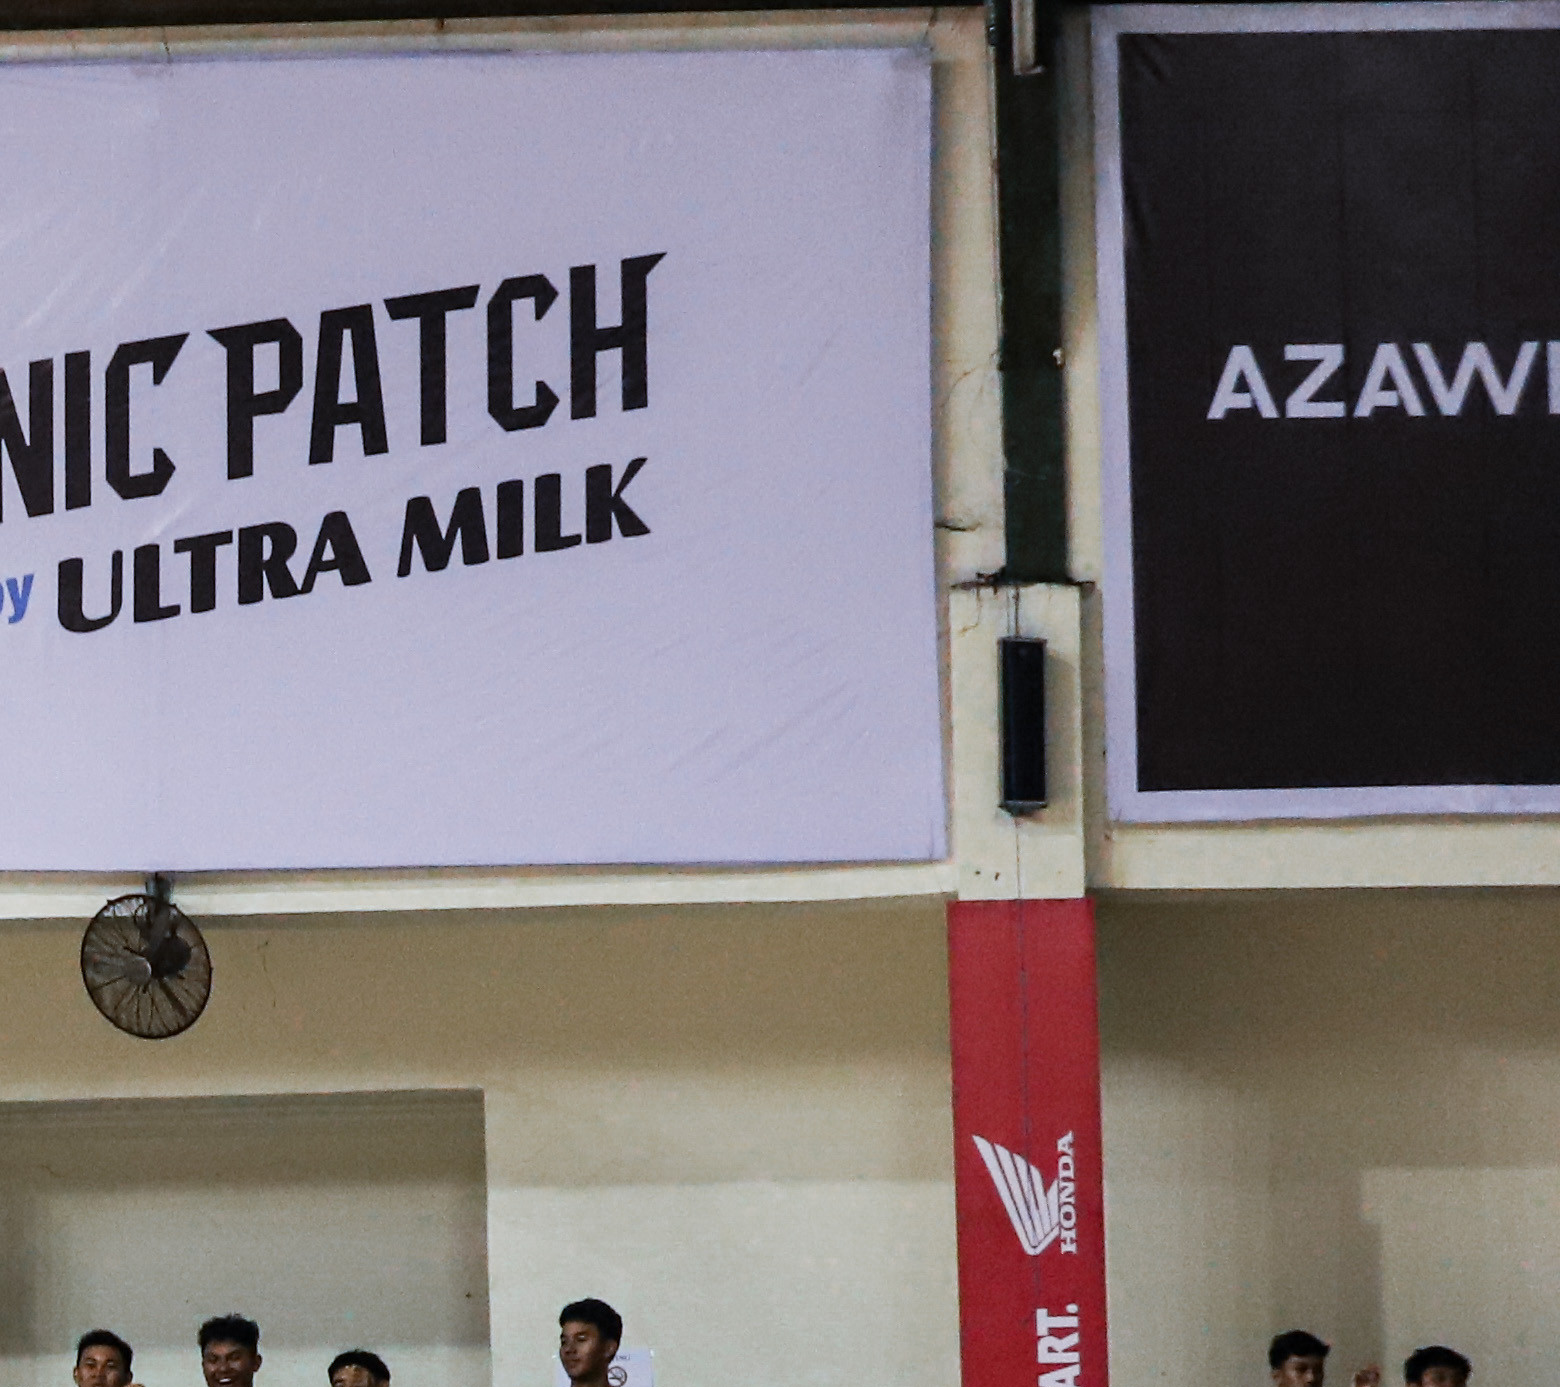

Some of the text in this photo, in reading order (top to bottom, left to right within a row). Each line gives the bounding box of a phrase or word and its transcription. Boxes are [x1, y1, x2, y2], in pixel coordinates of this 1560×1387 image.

[206, 252, 668, 481] PATCH
[58, 510, 372, 634] ULTRA
[397, 457, 651, 579] MILK
[1059, 1131, 1077, 1254] HONDA
